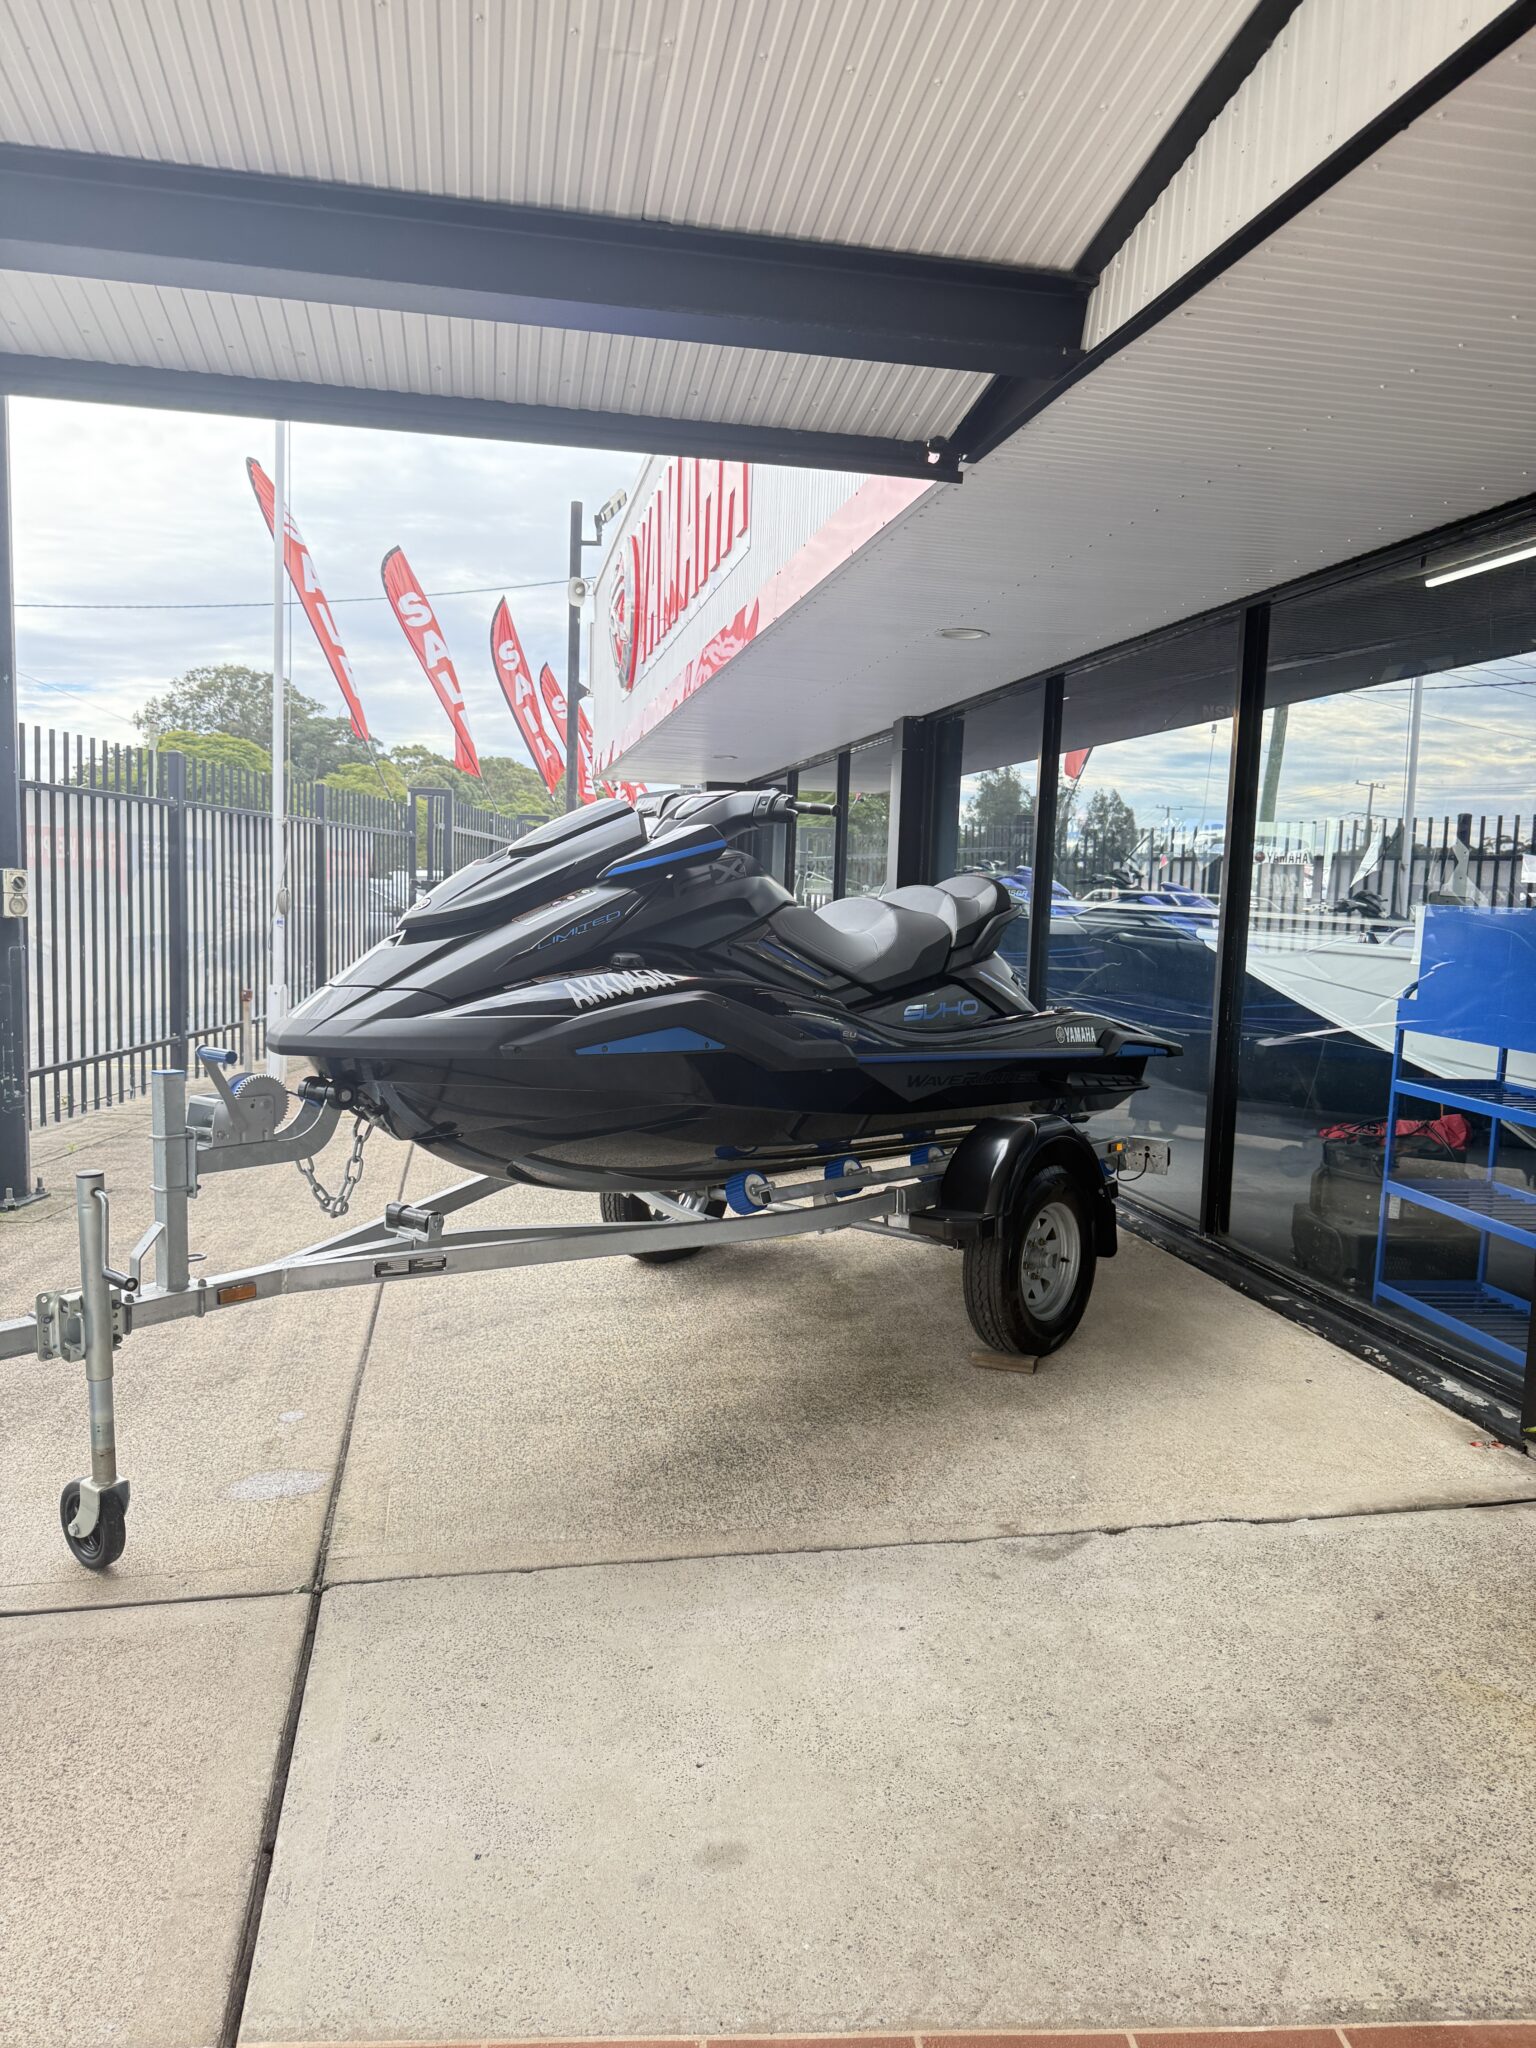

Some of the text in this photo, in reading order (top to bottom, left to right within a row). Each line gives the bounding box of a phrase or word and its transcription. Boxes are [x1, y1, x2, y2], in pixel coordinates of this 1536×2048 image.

[538, 910, 621, 949] LIMITED
[903, 999, 980, 1021] SVHO
[1064, 1026, 1096, 1042] YAMAHA
